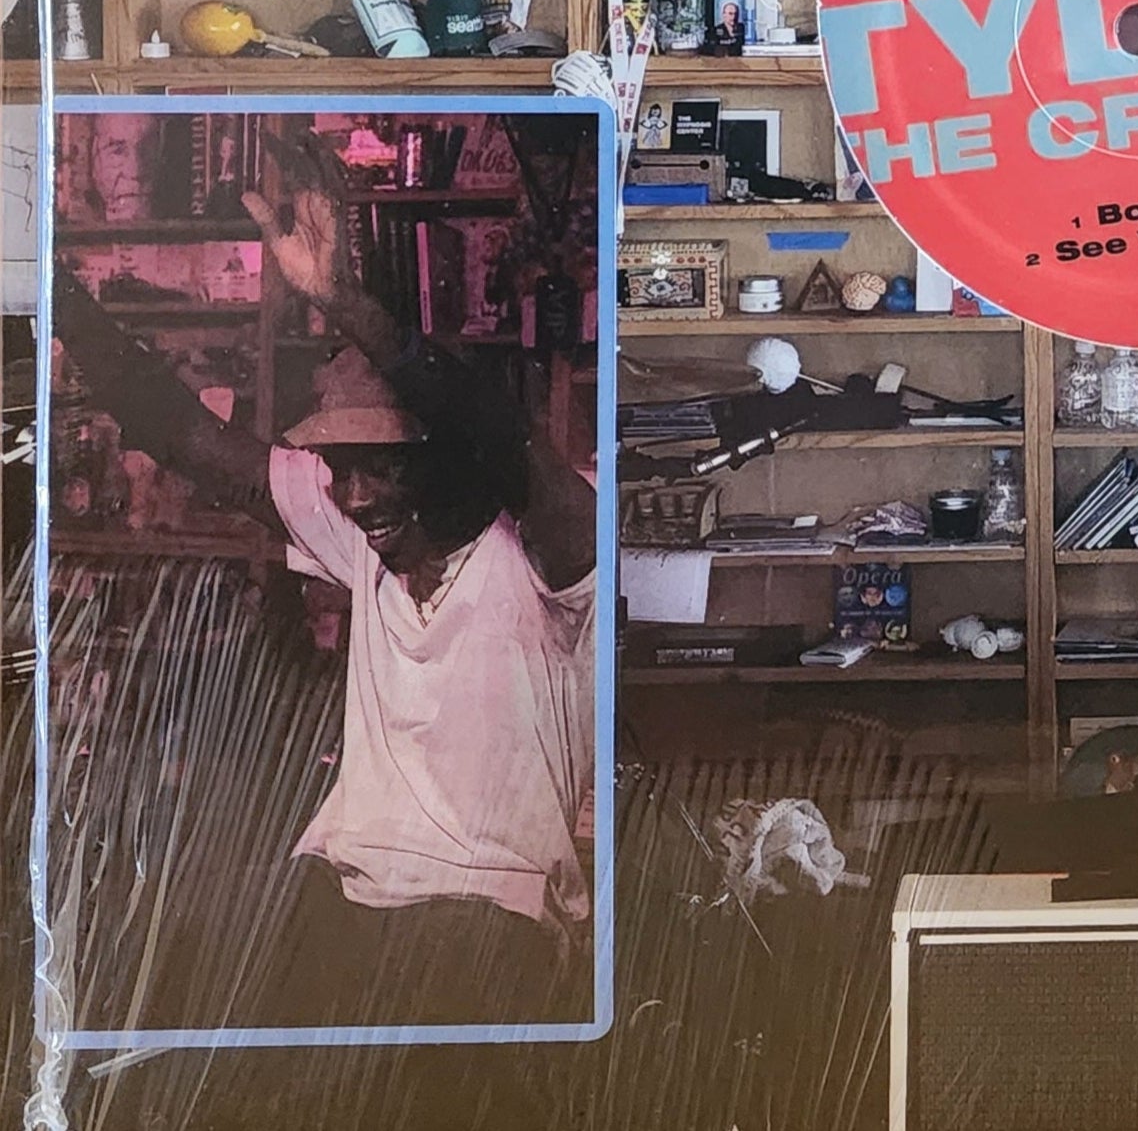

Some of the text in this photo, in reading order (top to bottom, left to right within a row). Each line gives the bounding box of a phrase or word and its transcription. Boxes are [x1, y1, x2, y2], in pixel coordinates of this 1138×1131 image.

[847, 116, 998, 183] HE
[1071, 217, 1082, 229] 1
[1025, 252, 1040, 266] 2
[1055, 234, 1134, 263] See
[842, 566, 902, 588] Opera
